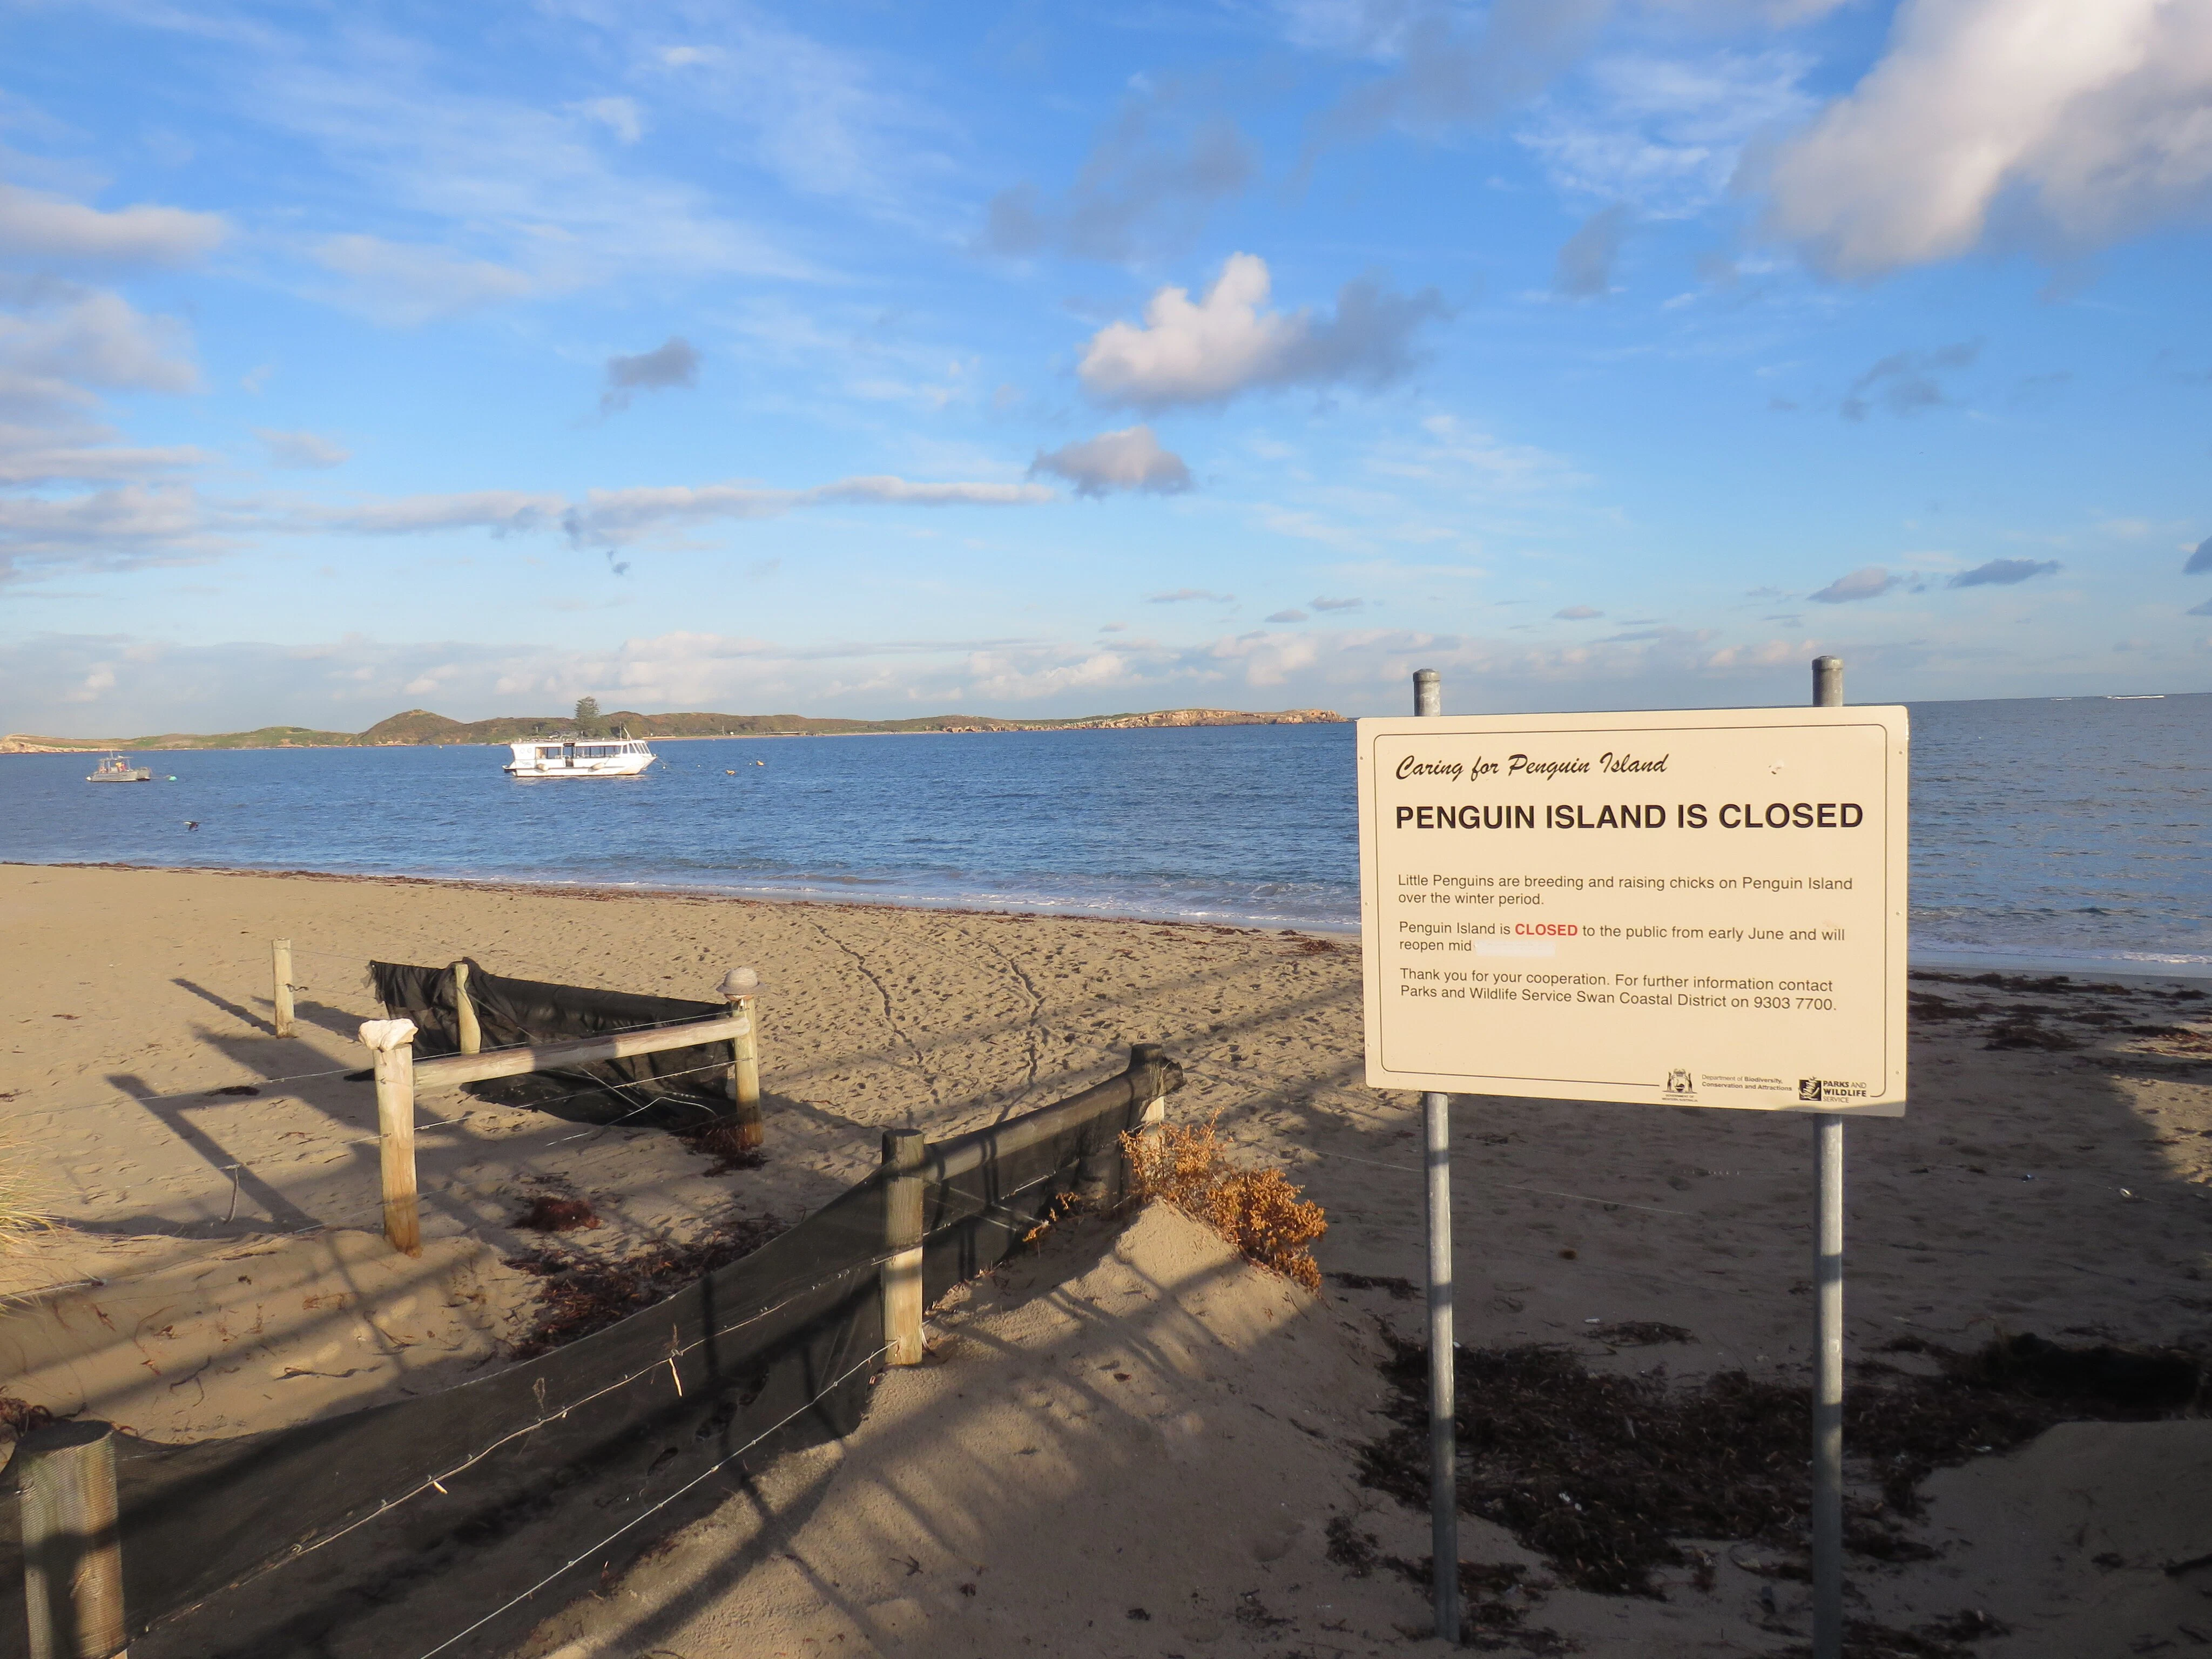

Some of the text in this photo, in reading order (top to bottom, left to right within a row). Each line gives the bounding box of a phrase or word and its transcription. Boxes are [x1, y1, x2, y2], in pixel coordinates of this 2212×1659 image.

[1396, 752, 1669, 782] Caring for Penguin Island
[1396, 802, 1863, 829] PENGUIN ISLAND IS CLOSED
[1399, 874, 1852, 892] Little Penguins are breeding and raising chicks on Penguin Island
[1399, 892, 1543, 907] over the winter period.
[1400, 921, 1844, 942] Penguin Island is CLOSED to the public from early June and will
[1400, 941, 1444, 953] reopen
[1400, 968, 1832, 992] Thank you for your cooperation. For further information contact
[1401, 985, 1836, 1010] Parks and Wildlife Service Swan Coastal District on 9303 7700.
[1823, 1088, 1867, 1097] WILDLIFE
